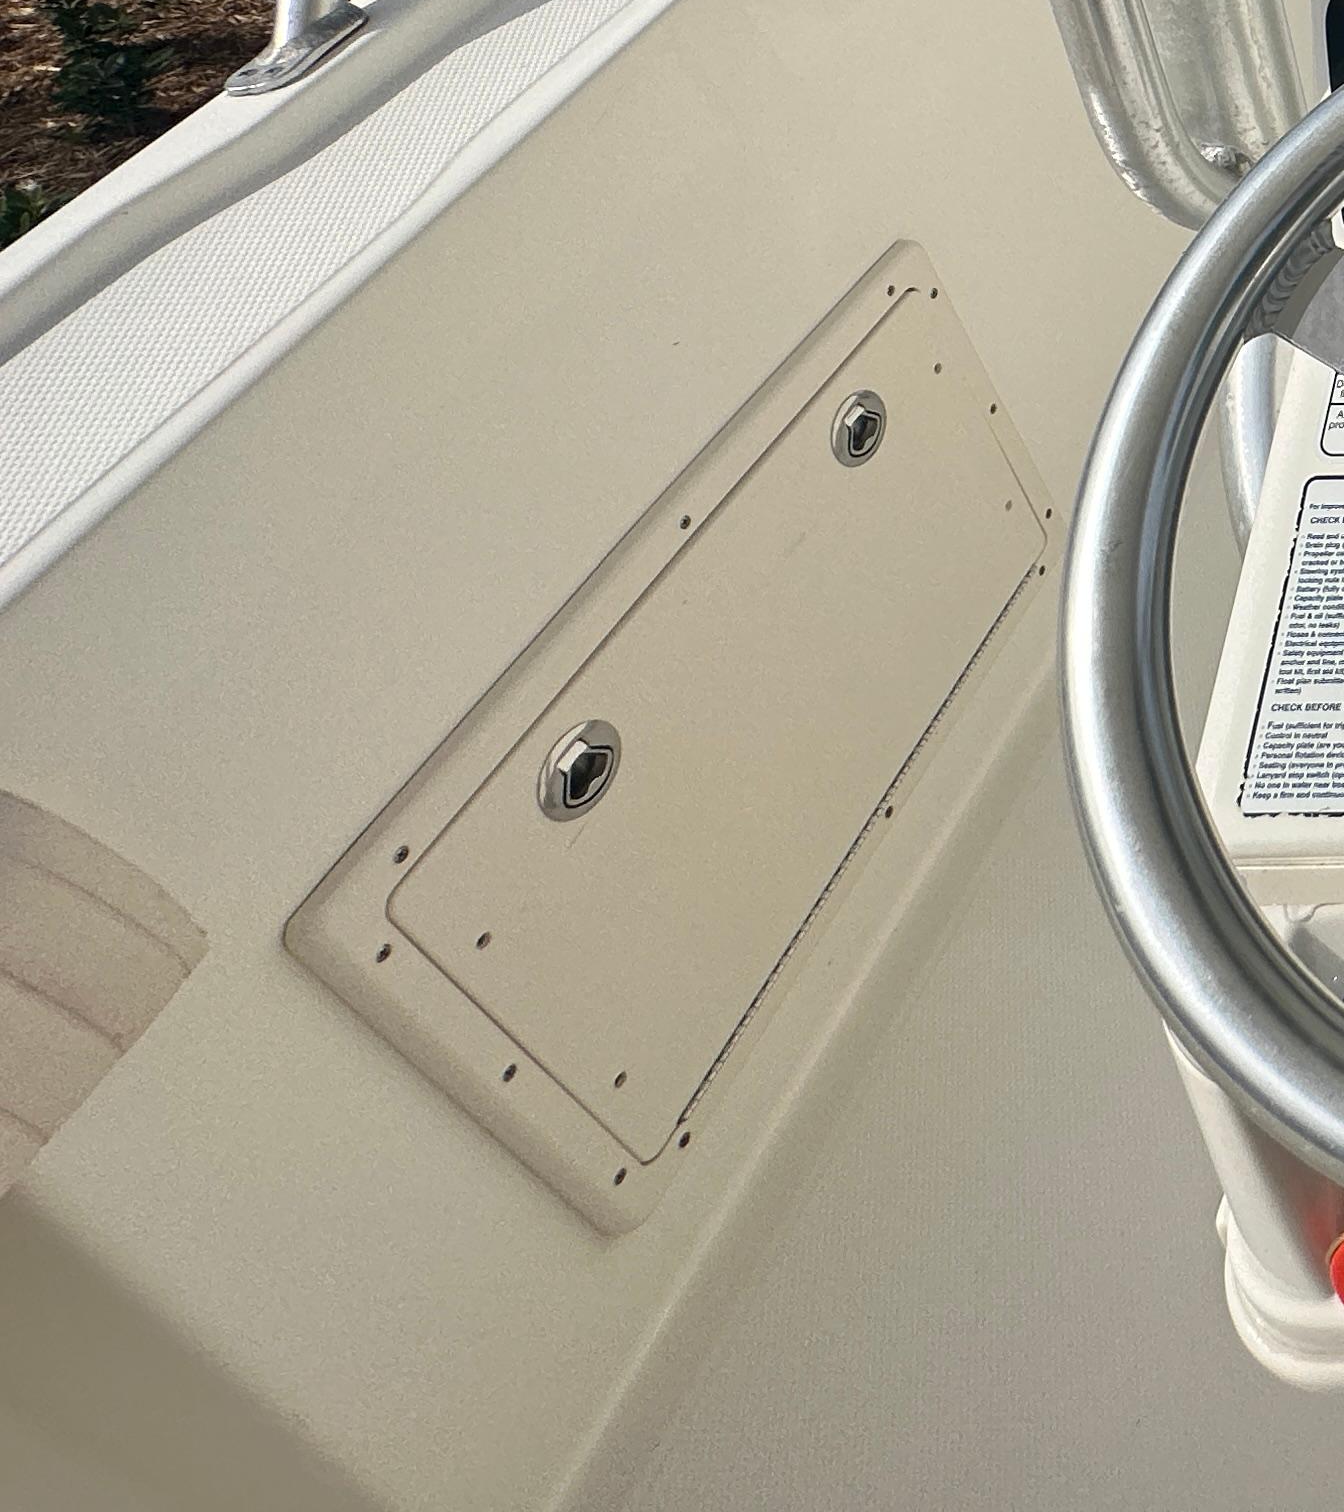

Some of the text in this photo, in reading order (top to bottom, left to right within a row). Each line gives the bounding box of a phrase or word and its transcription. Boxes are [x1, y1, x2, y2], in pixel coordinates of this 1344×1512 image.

[1310, 516, 1340, 524] CHECK
[1271, 703, 1302, 712] CHECK
[1305, 703, 1341, 711] BEFORE
